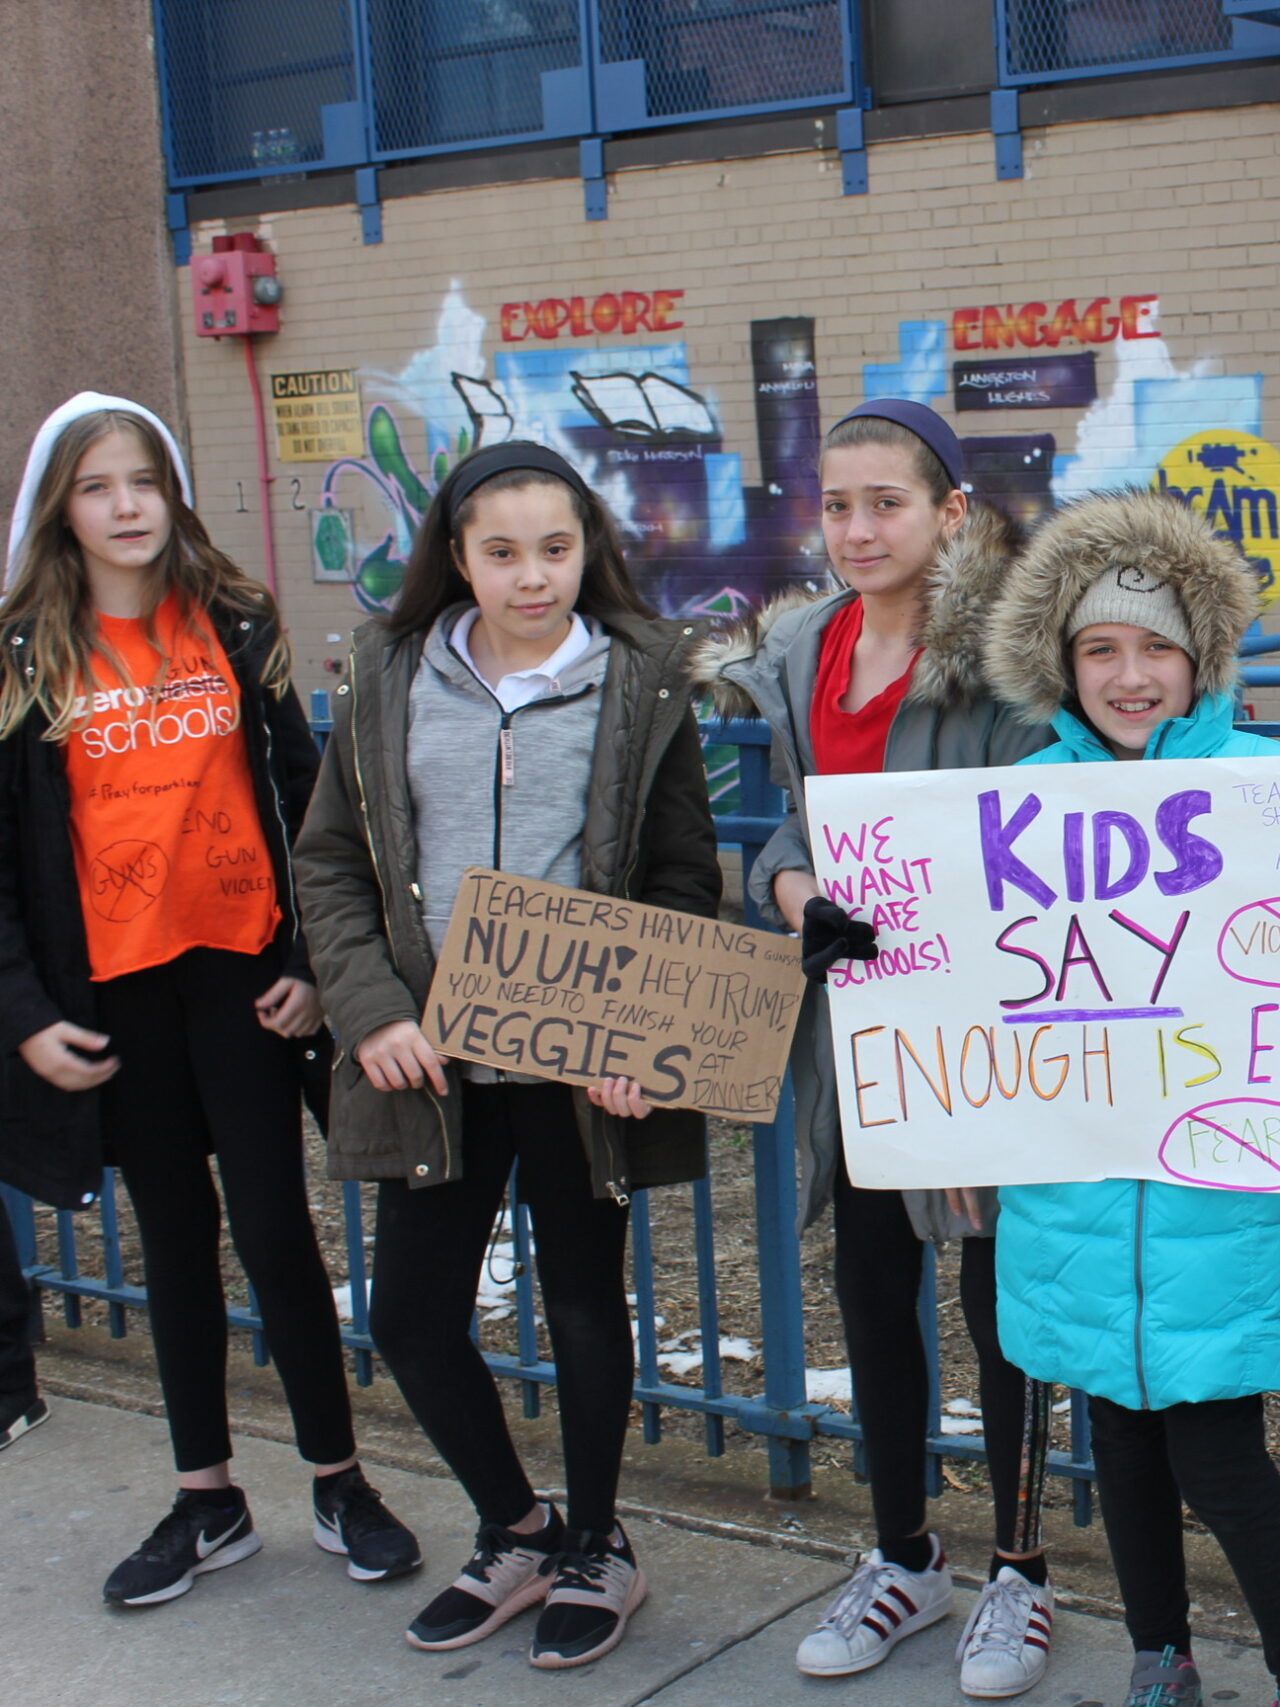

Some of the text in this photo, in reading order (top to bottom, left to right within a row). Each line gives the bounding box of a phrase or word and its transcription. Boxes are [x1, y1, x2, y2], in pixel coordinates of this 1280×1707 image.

[501, 289, 685, 342] EXPLORE
[953, 295, 1161, 350] ENGAGE
[274, 371, 354, 396] CAUTION
[236, 481, 249, 512] 1
[290, 478, 305, 510] 2
[81, 698, 233, 758] schools
[181, 807, 231, 834] END
[823, 816, 893, 864] WE
[93, 853, 157, 895] GUNS
[205, 846, 257, 868] GUN
[977, 789, 1224, 911] KIDS
[823, 858, 932, 905] WANT
[469, 874, 633, 932] TEACHERS
[639, 913, 757, 958] HAVING
[639, 954, 701, 1009] HEY
[995, 909, 1190, 1009] SAY
[448, 972, 491, 998] YOU
[602, 1001, 674, 1033] FINISH
[692, 1022, 748, 1052] YOUR
[437, 1002, 735, 1102] VEGGIES AT
[851, 1024, 1115, 1128] ENOUGH
[1157, 1023, 1223, 1098] IS
